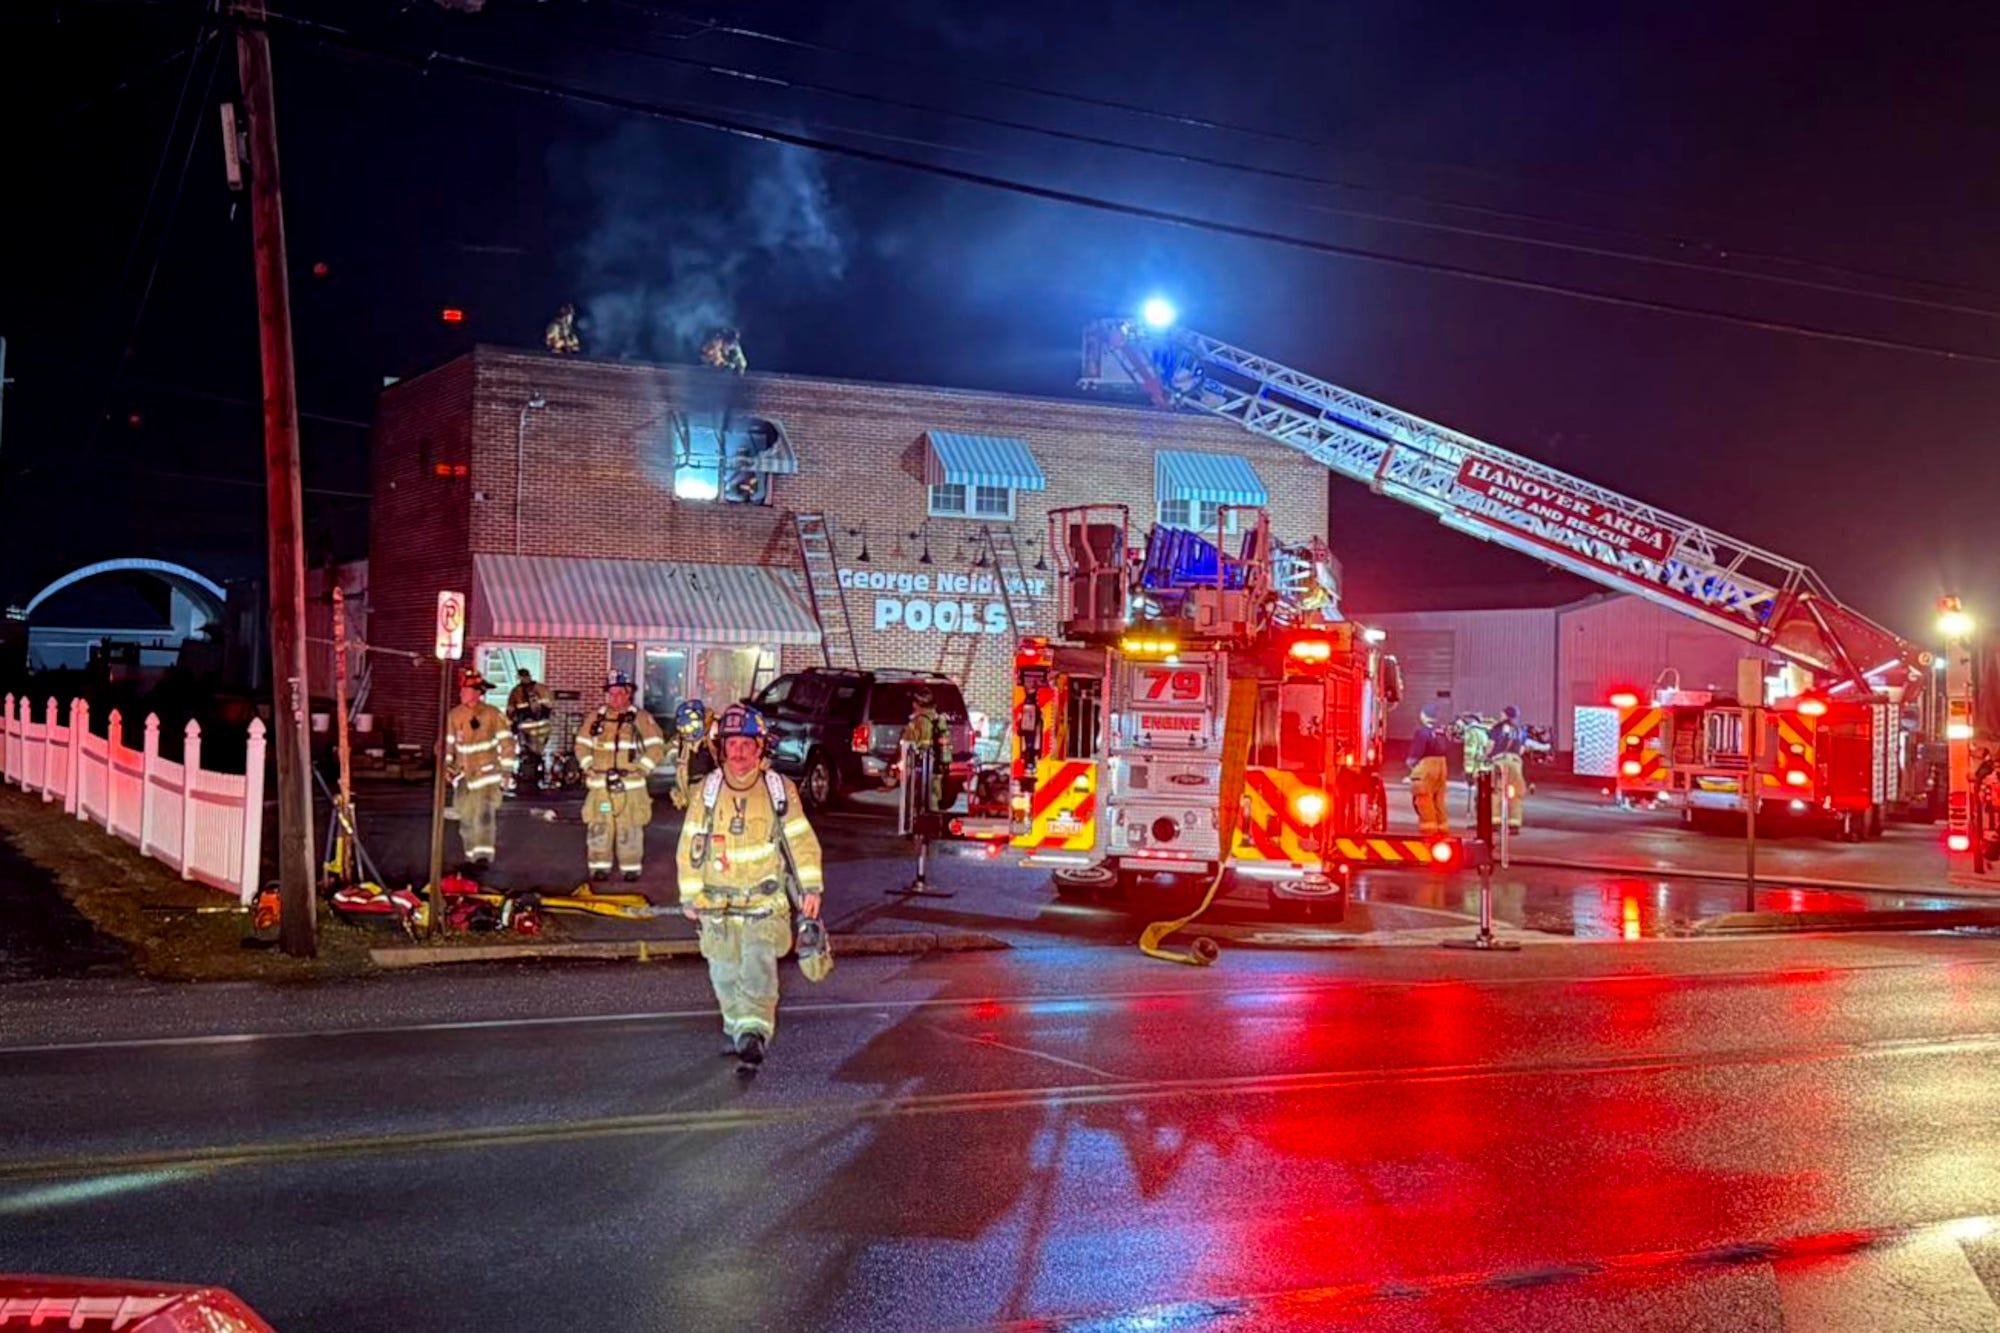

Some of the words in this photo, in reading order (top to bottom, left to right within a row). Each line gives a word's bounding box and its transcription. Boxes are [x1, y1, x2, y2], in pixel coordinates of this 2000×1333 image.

[1469, 461, 1591, 516] HANOVER
[1596, 511, 1664, 550] AREA
[1488, 485, 1524, 508] FIRE
[1527, 502, 1564, 522] AND
[1566, 517, 1632, 549] RESCUE
[838, 568, 929, 593] George
[875, 599, 1007, 634] POOLS
[1143, 670, 1202, 700] 79
[1142, 715, 1201, 731] ENGINE
